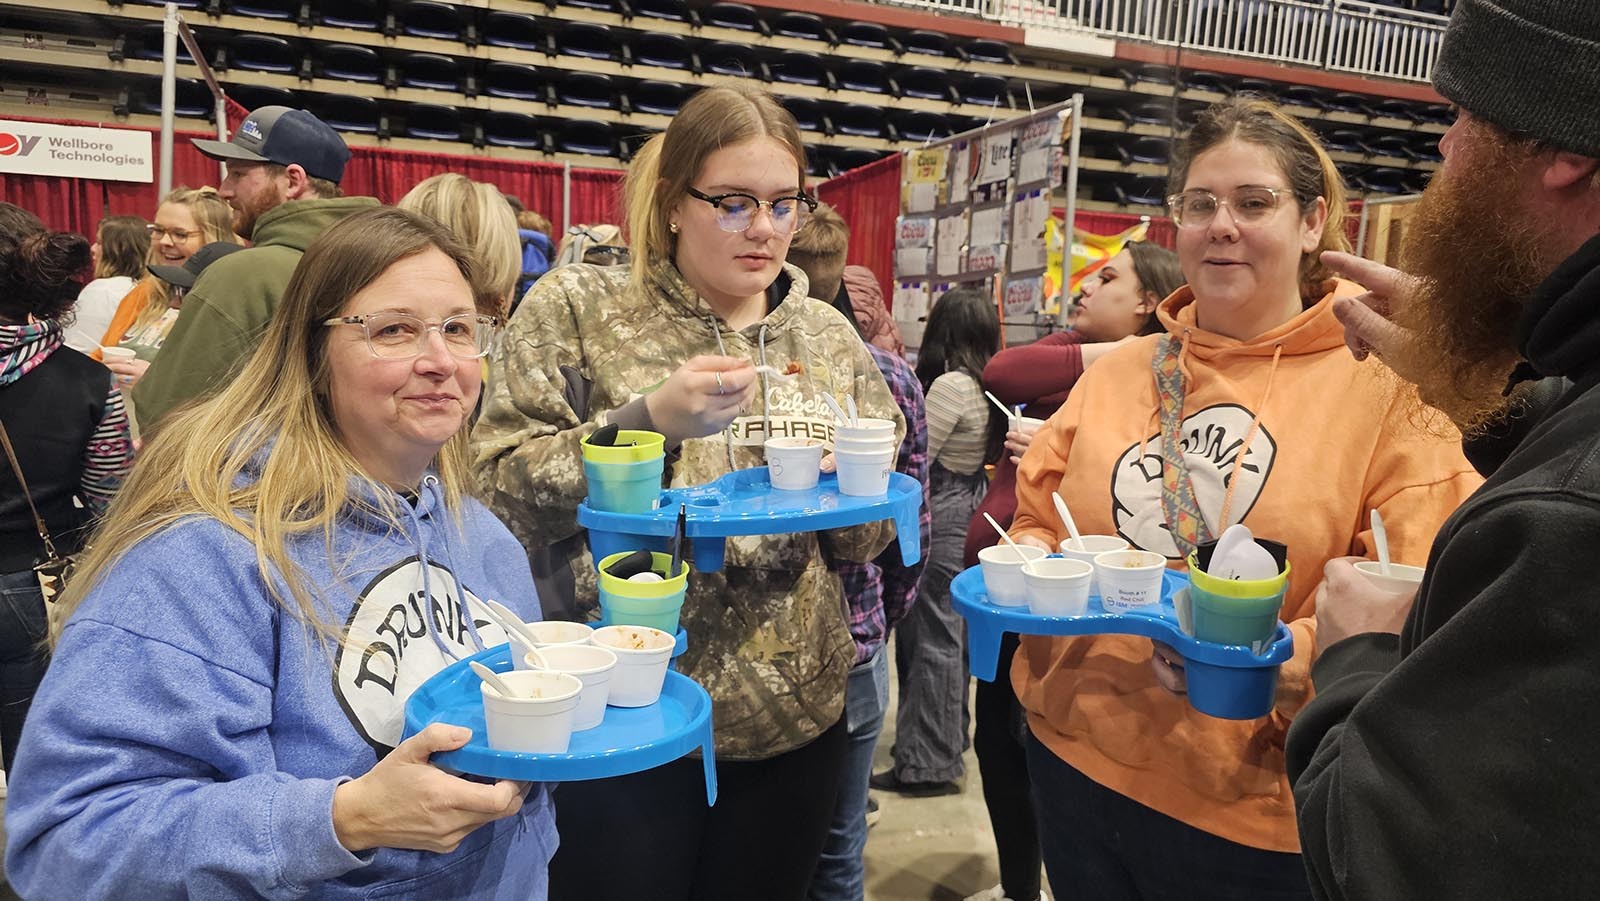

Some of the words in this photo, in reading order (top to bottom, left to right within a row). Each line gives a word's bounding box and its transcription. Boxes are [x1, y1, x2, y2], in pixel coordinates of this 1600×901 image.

[49, 137, 113, 151] Wellbore
[49, 150, 145, 166] Technologies
[768, 386, 836, 417] Cabela
[1129, 423, 1260, 483] DUNK
[354, 590, 491, 696] DRUNK
